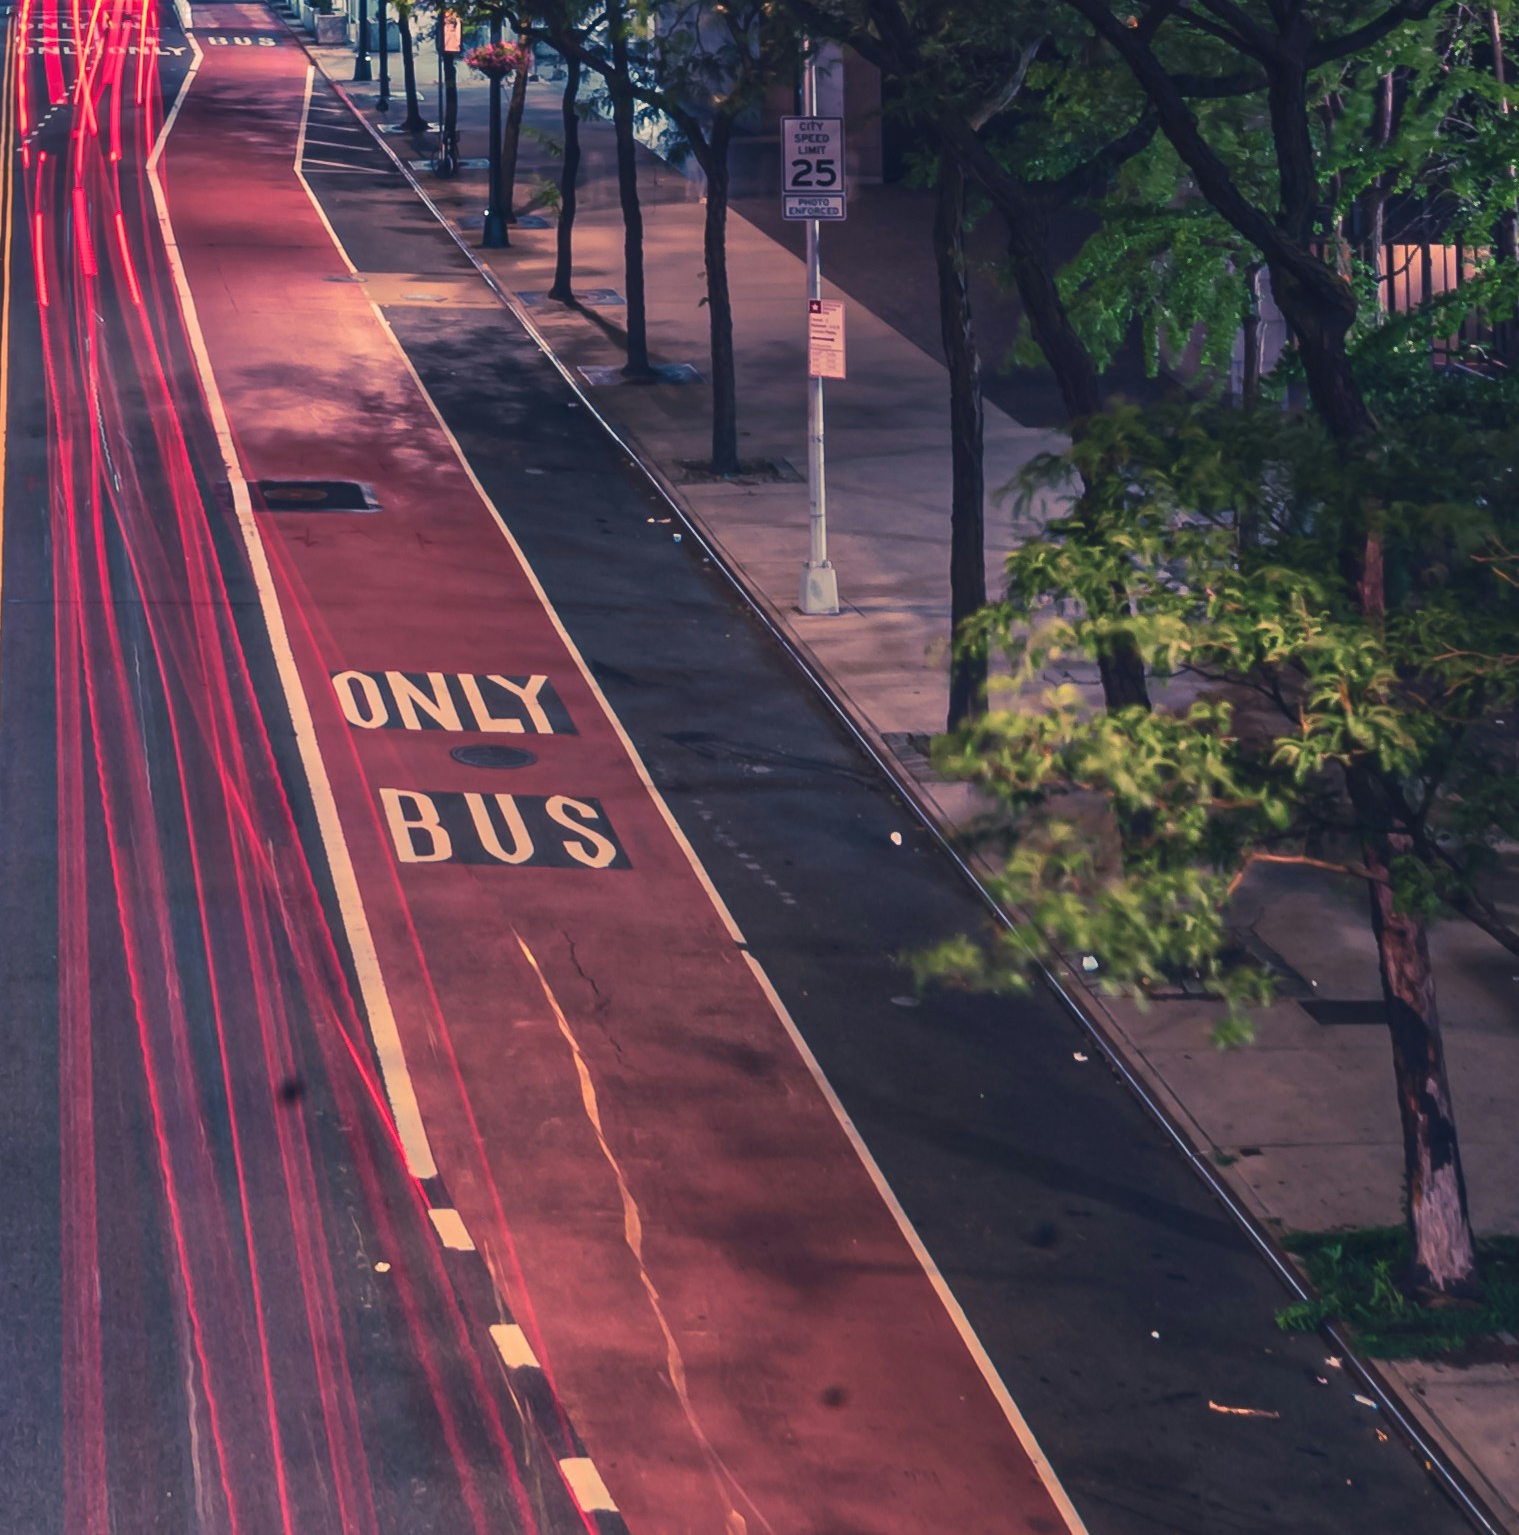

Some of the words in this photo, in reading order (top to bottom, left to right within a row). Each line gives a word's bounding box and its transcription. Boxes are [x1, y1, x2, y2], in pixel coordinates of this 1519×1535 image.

[207, 36, 277, 47] BUS
[107, 46, 187, 56] ONLY
[799, 121, 824, 131] CITY
[794, 133, 830, 143] SPEED
[797, 145, 827, 155] LIMIT
[791, 159, 837, 187] 25
[798, 198, 830, 206] PHOTO
[788, 206, 840, 215] ENFORCED
[331, 670, 555, 735] ONLY
[378, 787, 617, 869] BUS
